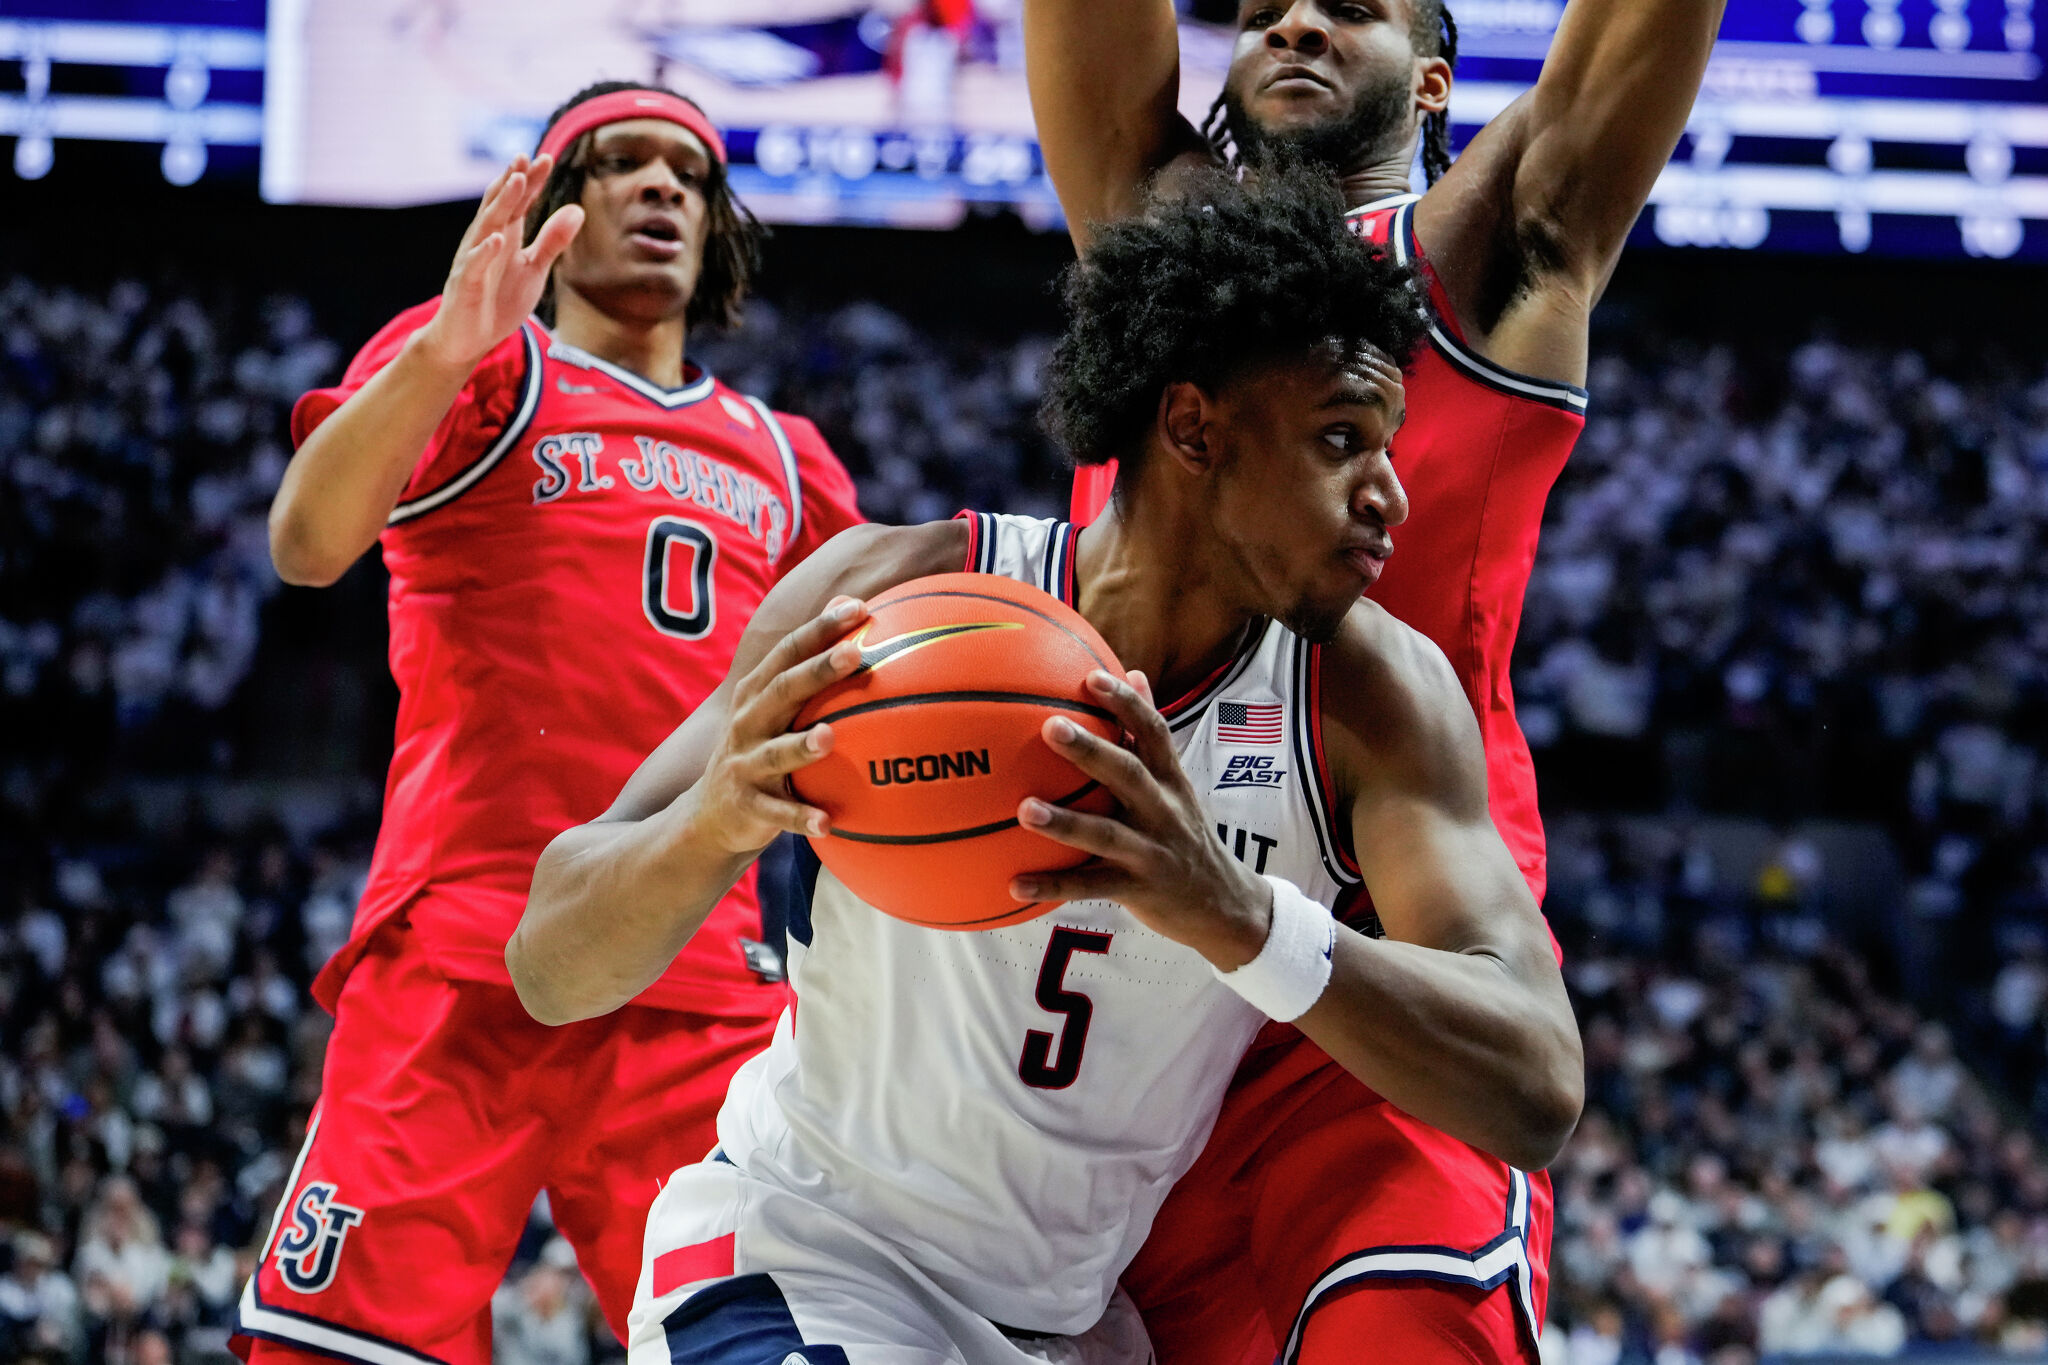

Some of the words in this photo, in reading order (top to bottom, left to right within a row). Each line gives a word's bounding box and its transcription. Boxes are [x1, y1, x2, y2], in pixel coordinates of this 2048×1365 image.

[533, 433, 615, 505] ST.
[642, 515, 718, 641] 0
[868, 748, 991, 787] UCONN
[1219, 770, 1287, 784] EAST
[1227, 755, 1275, 769] BIG
[1018, 925, 1114, 1090] 5
